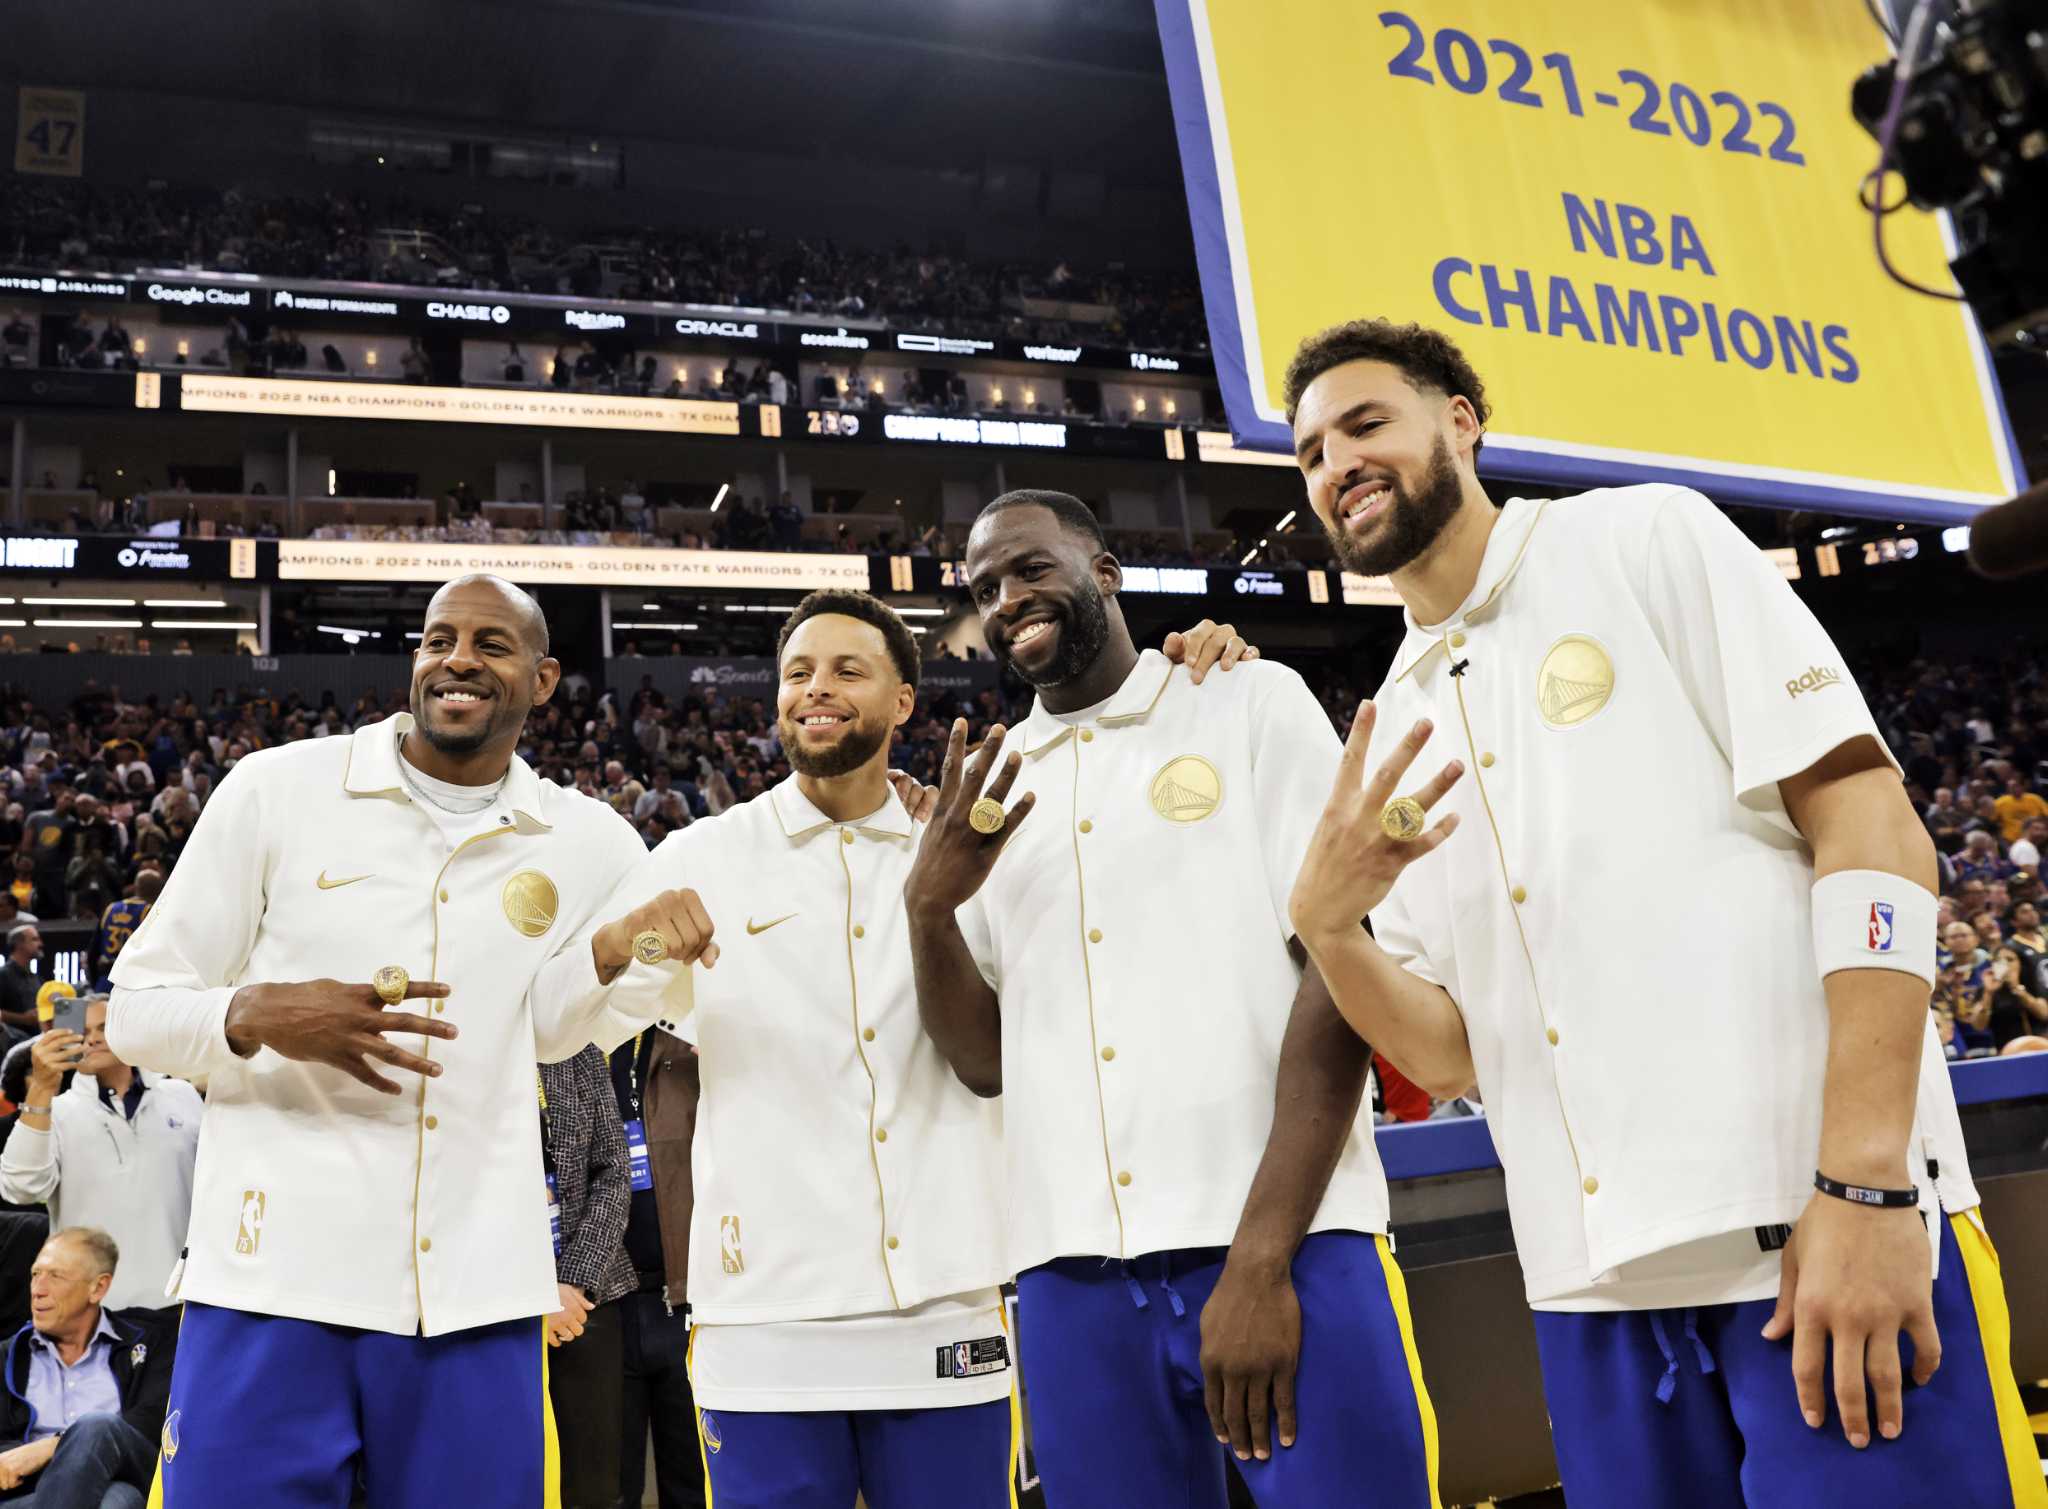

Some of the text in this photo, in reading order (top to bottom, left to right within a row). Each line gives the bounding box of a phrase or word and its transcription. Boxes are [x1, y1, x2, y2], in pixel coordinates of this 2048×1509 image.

[1378, 11, 1806, 166] 2021-2022
[25, 119, 76, 155] 47
[1561, 192, 1717, 276] NBA
[148, 284, 250, 305] Google Cloud
[427, 302, 491, 321] CHASE
[565, 310, 625, 329] Rakuten
[1432, 257, 1859, 384] CHAMPIONS
[675, 319, 758, 338] ORACLE
[308, 394, 341, 404] NBA
[347, 395, 446, 408] CHAMPIONS
[460, 401, 525, 412] GOLDEN
[530, 404, 576, 414] STATE
[581, 407, 663, 418] WARRIORS
[375, 557, 421, 567] 2022
[427, 558, 463, 568] NBA
[469, 558, 574, 570] CHAMPIONS
[588, 561, 655, 572] GOLDEN
[661, 563, 711, 573] STATE
[715, 564, 803, 576] WARRIORS
[252, 657, 279, 671] 103
[715, 664, 773, 685] Sports
